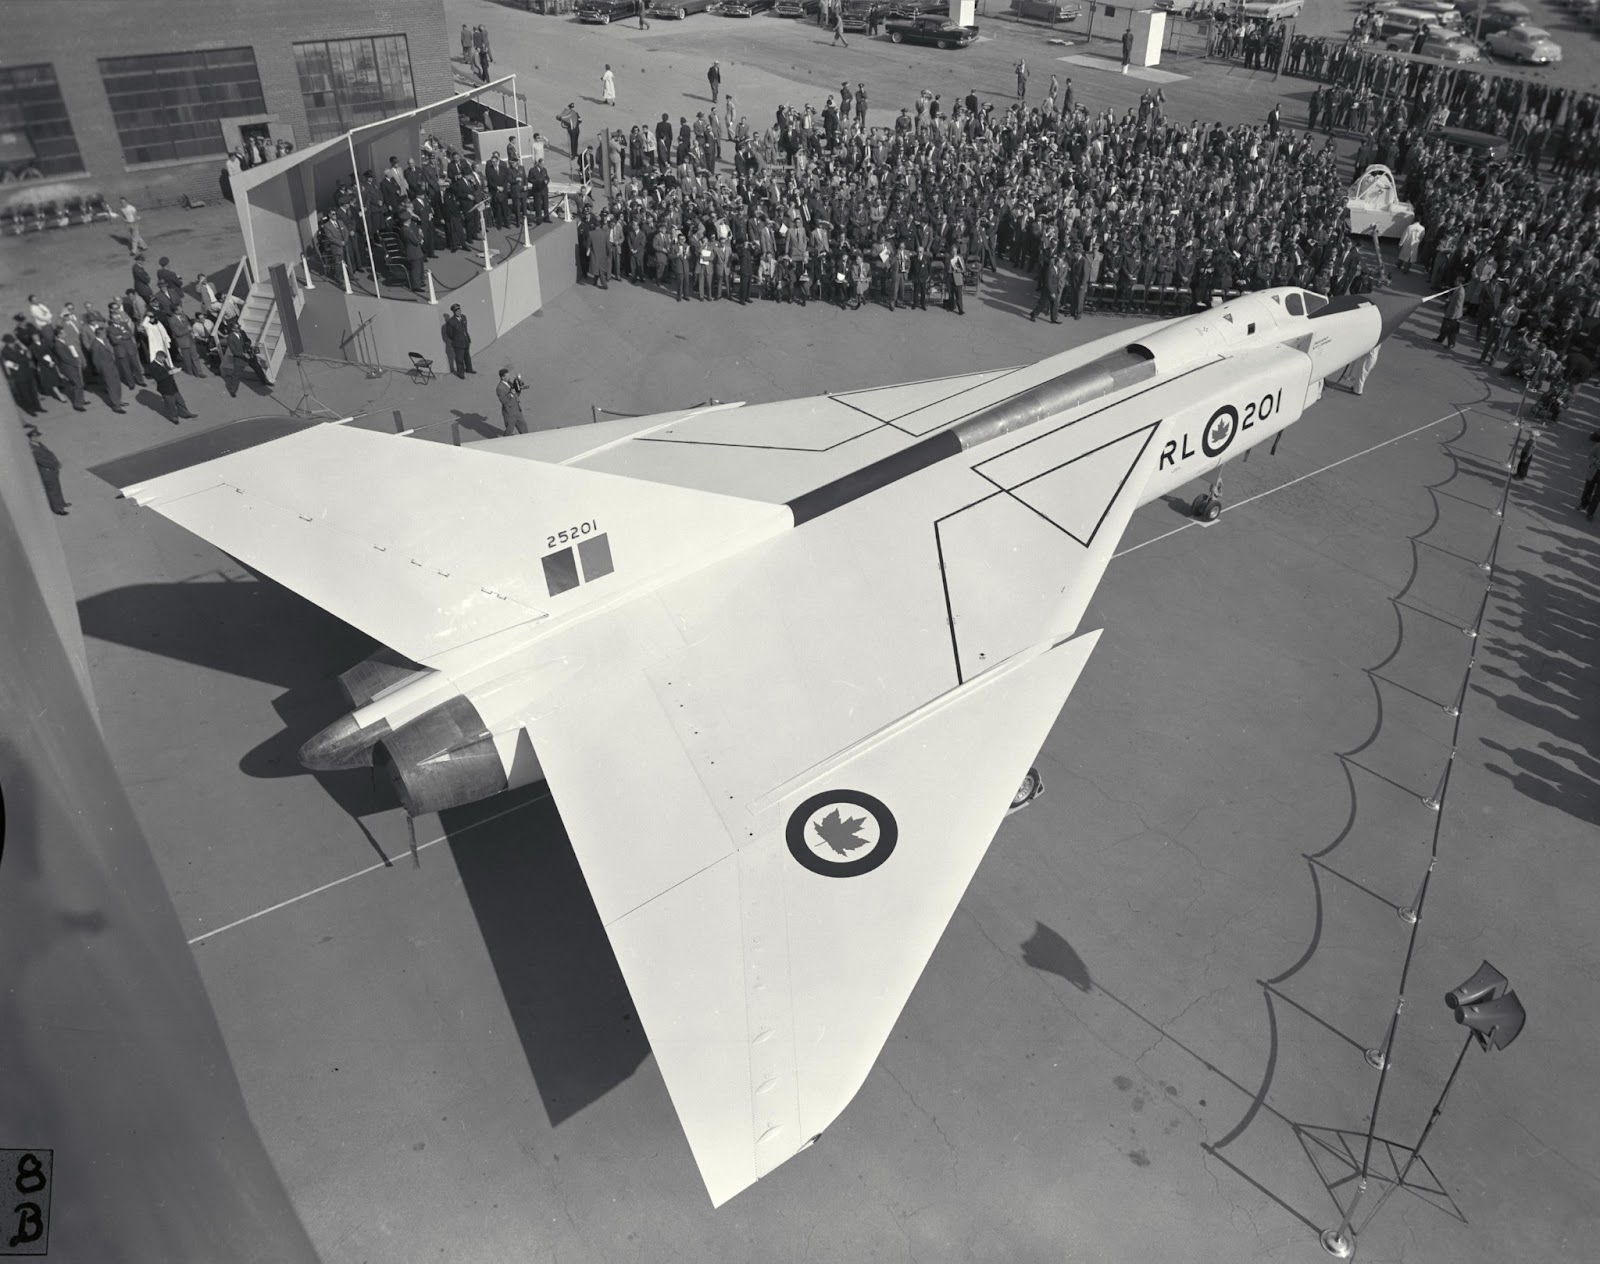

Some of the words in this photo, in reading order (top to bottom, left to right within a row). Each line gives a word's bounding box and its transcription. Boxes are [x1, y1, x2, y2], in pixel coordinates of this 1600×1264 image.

[1159, 433, 1195, 471] RL
[1241, 387, 1283, 431] 201
[546, 519, 598, 548] 25201
